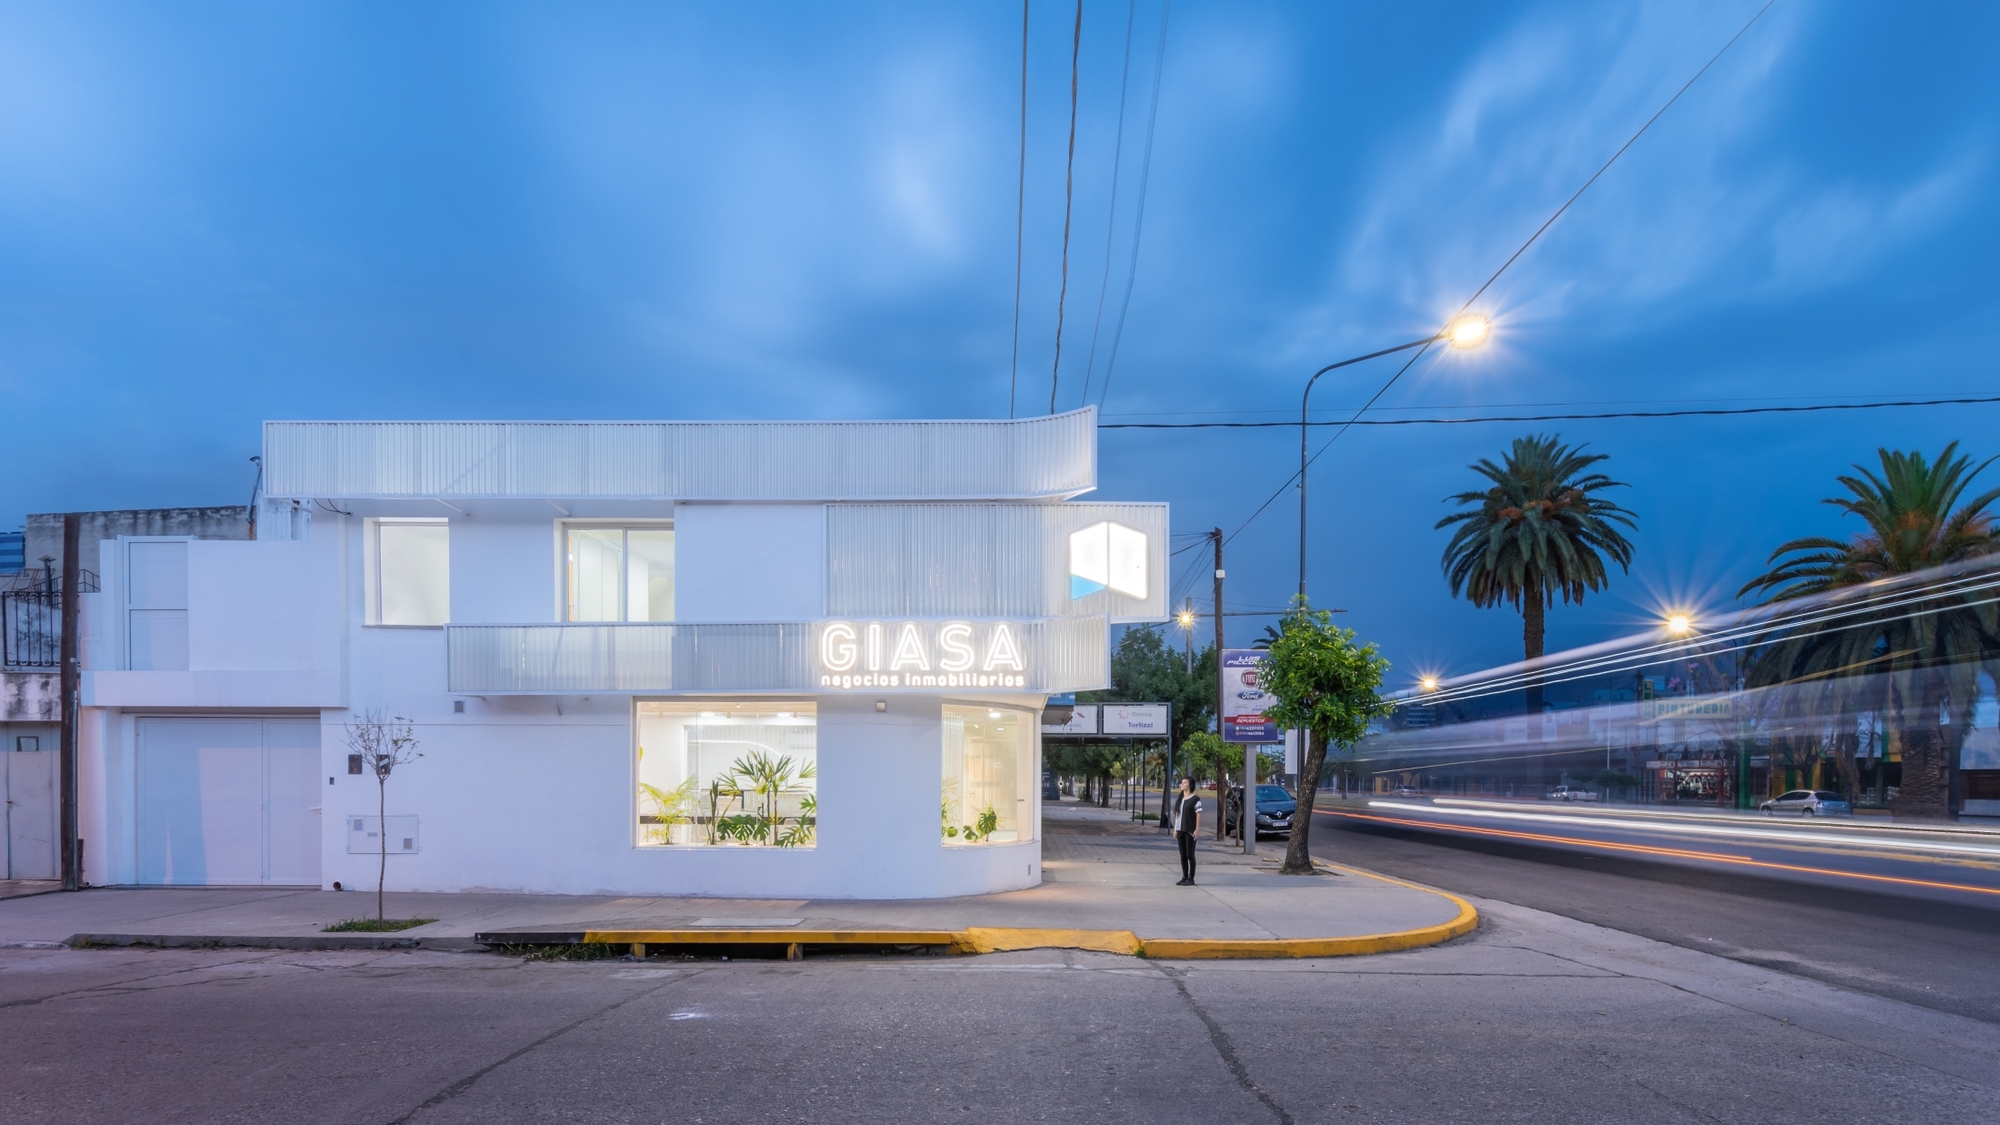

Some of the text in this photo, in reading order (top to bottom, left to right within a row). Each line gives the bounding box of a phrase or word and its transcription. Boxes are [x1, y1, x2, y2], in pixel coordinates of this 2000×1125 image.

[821, 623, 1024, 671] GIASA
[821, 673, 1025, 689] negocios inmobiliarios
[1245, 675, 1256, 683] FIAT
